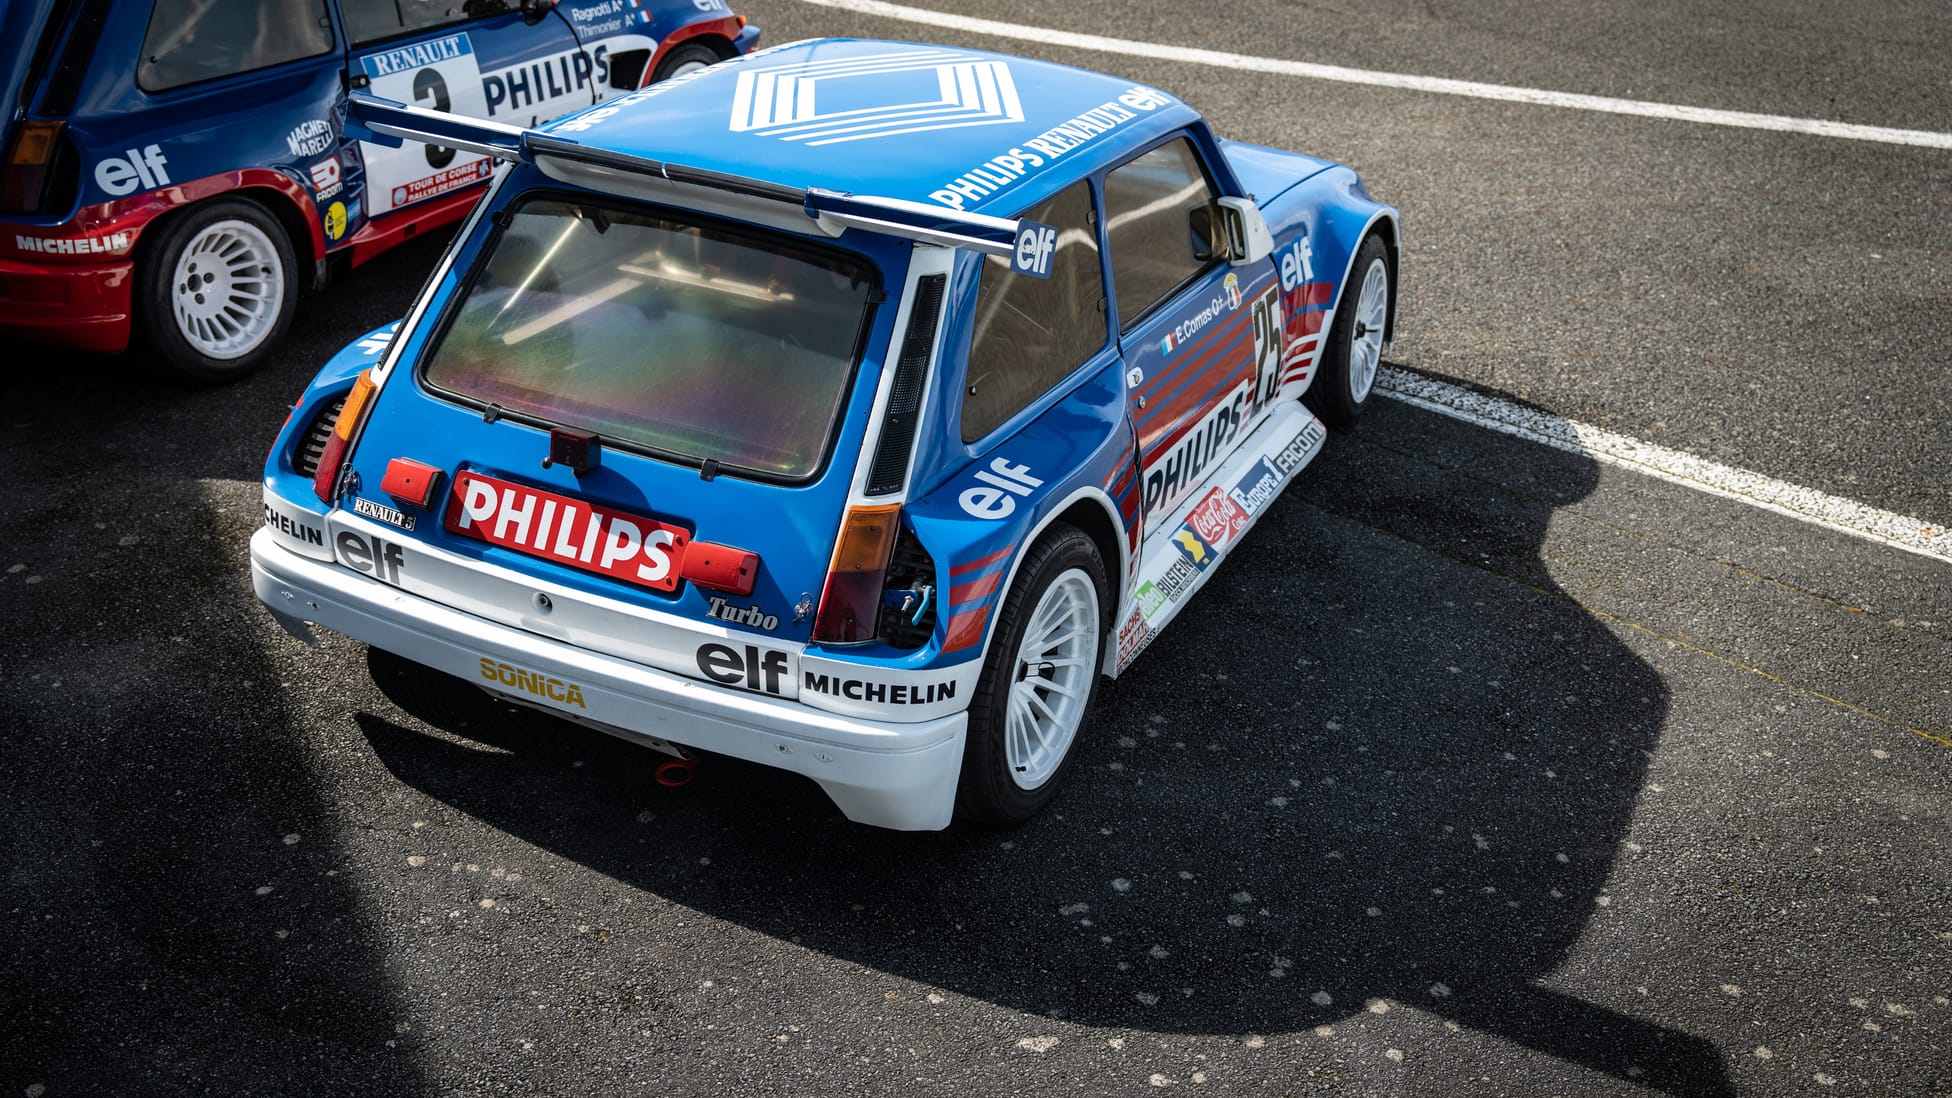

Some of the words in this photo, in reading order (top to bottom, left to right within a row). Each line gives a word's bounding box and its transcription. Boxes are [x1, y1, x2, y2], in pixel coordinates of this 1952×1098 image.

[577, 18, 622, 39] Thimonier
[374, 37, 461, 76] RENAULT
[482, 44, 609, 117] PHILIPS
[94, 144, 171, 196] elf
[928, 148, 1044, 211] PHILIPS
[1022, 102, 1137, 159] RENAULT
[1118, 86, 1172, 112] elf
[408, 178, 434, 193] TOUR
[435, 172, 447, 184] DE
[448, 163, 478, 179] CORSE
[408, 187, 437, 202] RALLYE
[438, 182, 448, 192] DE
[16, 233, 129, 255] MICHELIN
[1016, 227, 1056, 275] elf
[1281, 236, 1315, 293] elf
[1250, 286, 1282, 419] 25
[1143, 391, 1244, 520] PHILIPS
[1275, 422, 1323, 473] FACOM
[958, 456, 1045, 520] elf
[354, 499, 404, 527] RENAULT
[405, 517, 415, 530] 5
[458, 479, 677, 581] PHILIPS
[337, 531, 405, 586] elf
[1156, 555, 1194, 597] BILSTEIN
[706, 597, 778, 632] Turbo
[1119, 607, 1141, 646] SACHS
[696, 643, 788, 695] elf
[804, 672, 957, 705] MICHELIN
